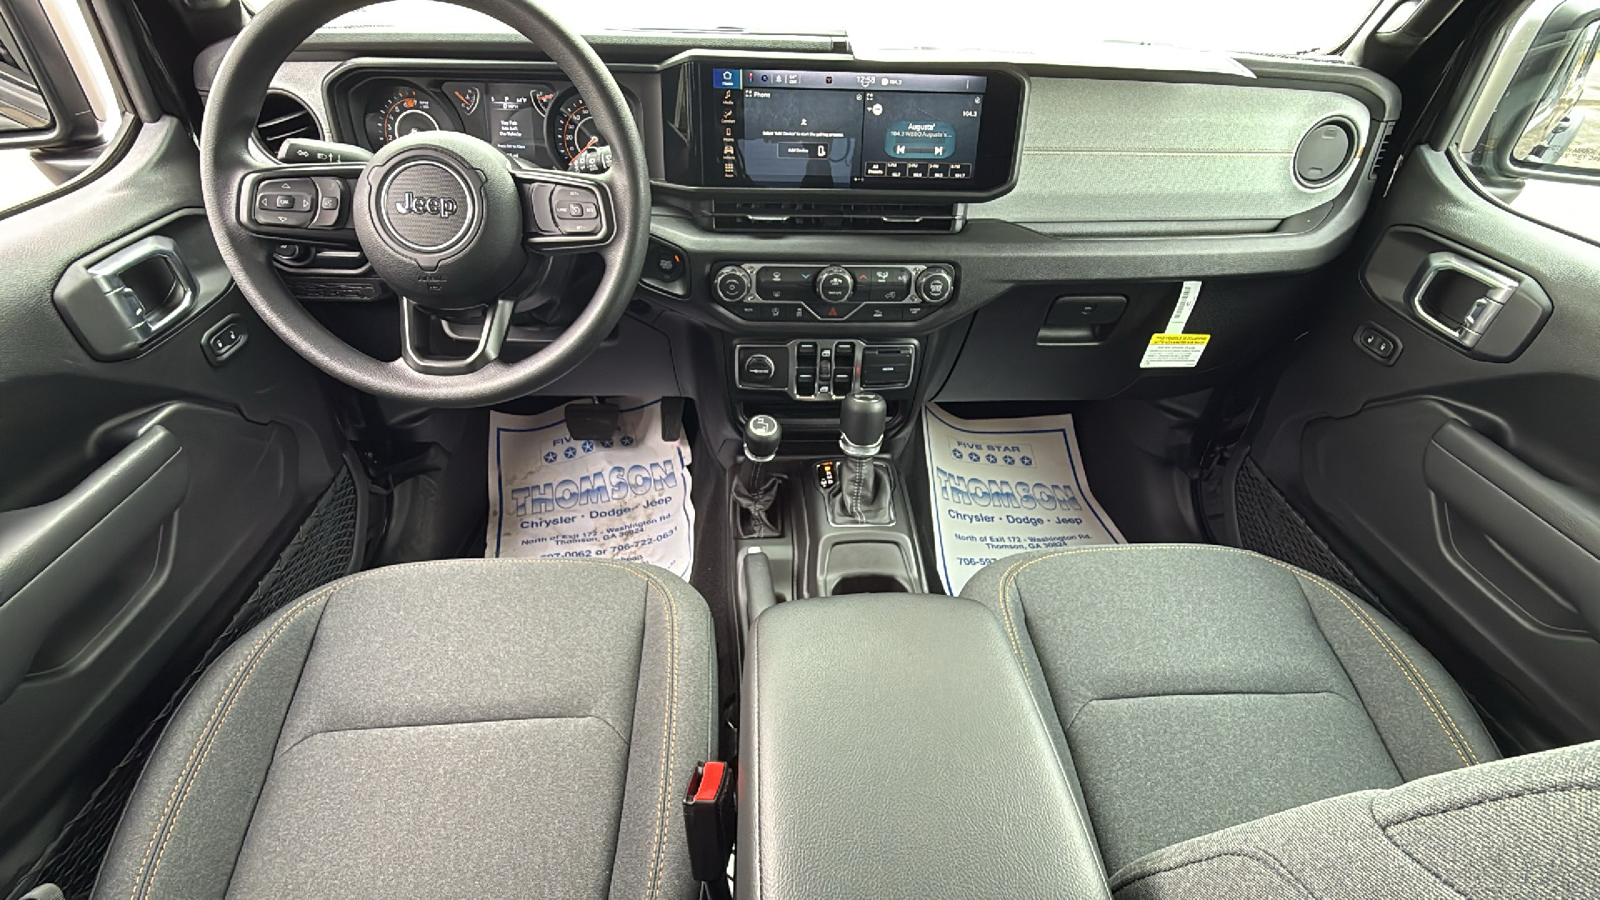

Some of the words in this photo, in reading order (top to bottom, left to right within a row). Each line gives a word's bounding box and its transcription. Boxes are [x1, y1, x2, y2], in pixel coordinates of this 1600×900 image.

[856, 76, 876, 84] 12:53
[396, 192, 457, 218] Jeep
[553, 436, 573, 447] FIV
[957, 441, 983, 450] FIVE
[987, 444, 1021, 452] STAR
[512, 460, 677, 517] THOMSON
[937, 467, 1082, 510] THOMSON
[520, 516, 577, 529] Chrysler
[590, 507, 632, 519] Dodge
[643, 496, 672, 509] Jeep
[948, 510, 995, 523] Chrysler
[1006, 515, 1044, 526] Dodge
[1055, 517, 1083, 525] Jeep
[521, 537, 547, 546] North
[550, 535, 559, 543] of
[561, 533, 579, 541] Exit
[582, 530, 597, 538] 172
[606, 517, 657, 535] Washington
[659, 514, 673, 524] Rd.
[555, 537, 600, 546] Thomson,
[603, 532, 617, 540] GA
[610, 526, 678, 551] 706-722-0631
[955, 533, 977, 542] North
[980, 534, 988, 542] of
[990, 535, 1005, 543] Exit
[1028, 535, 1075, 545] Washington
[1044, 541, 1067, 549] 30824
